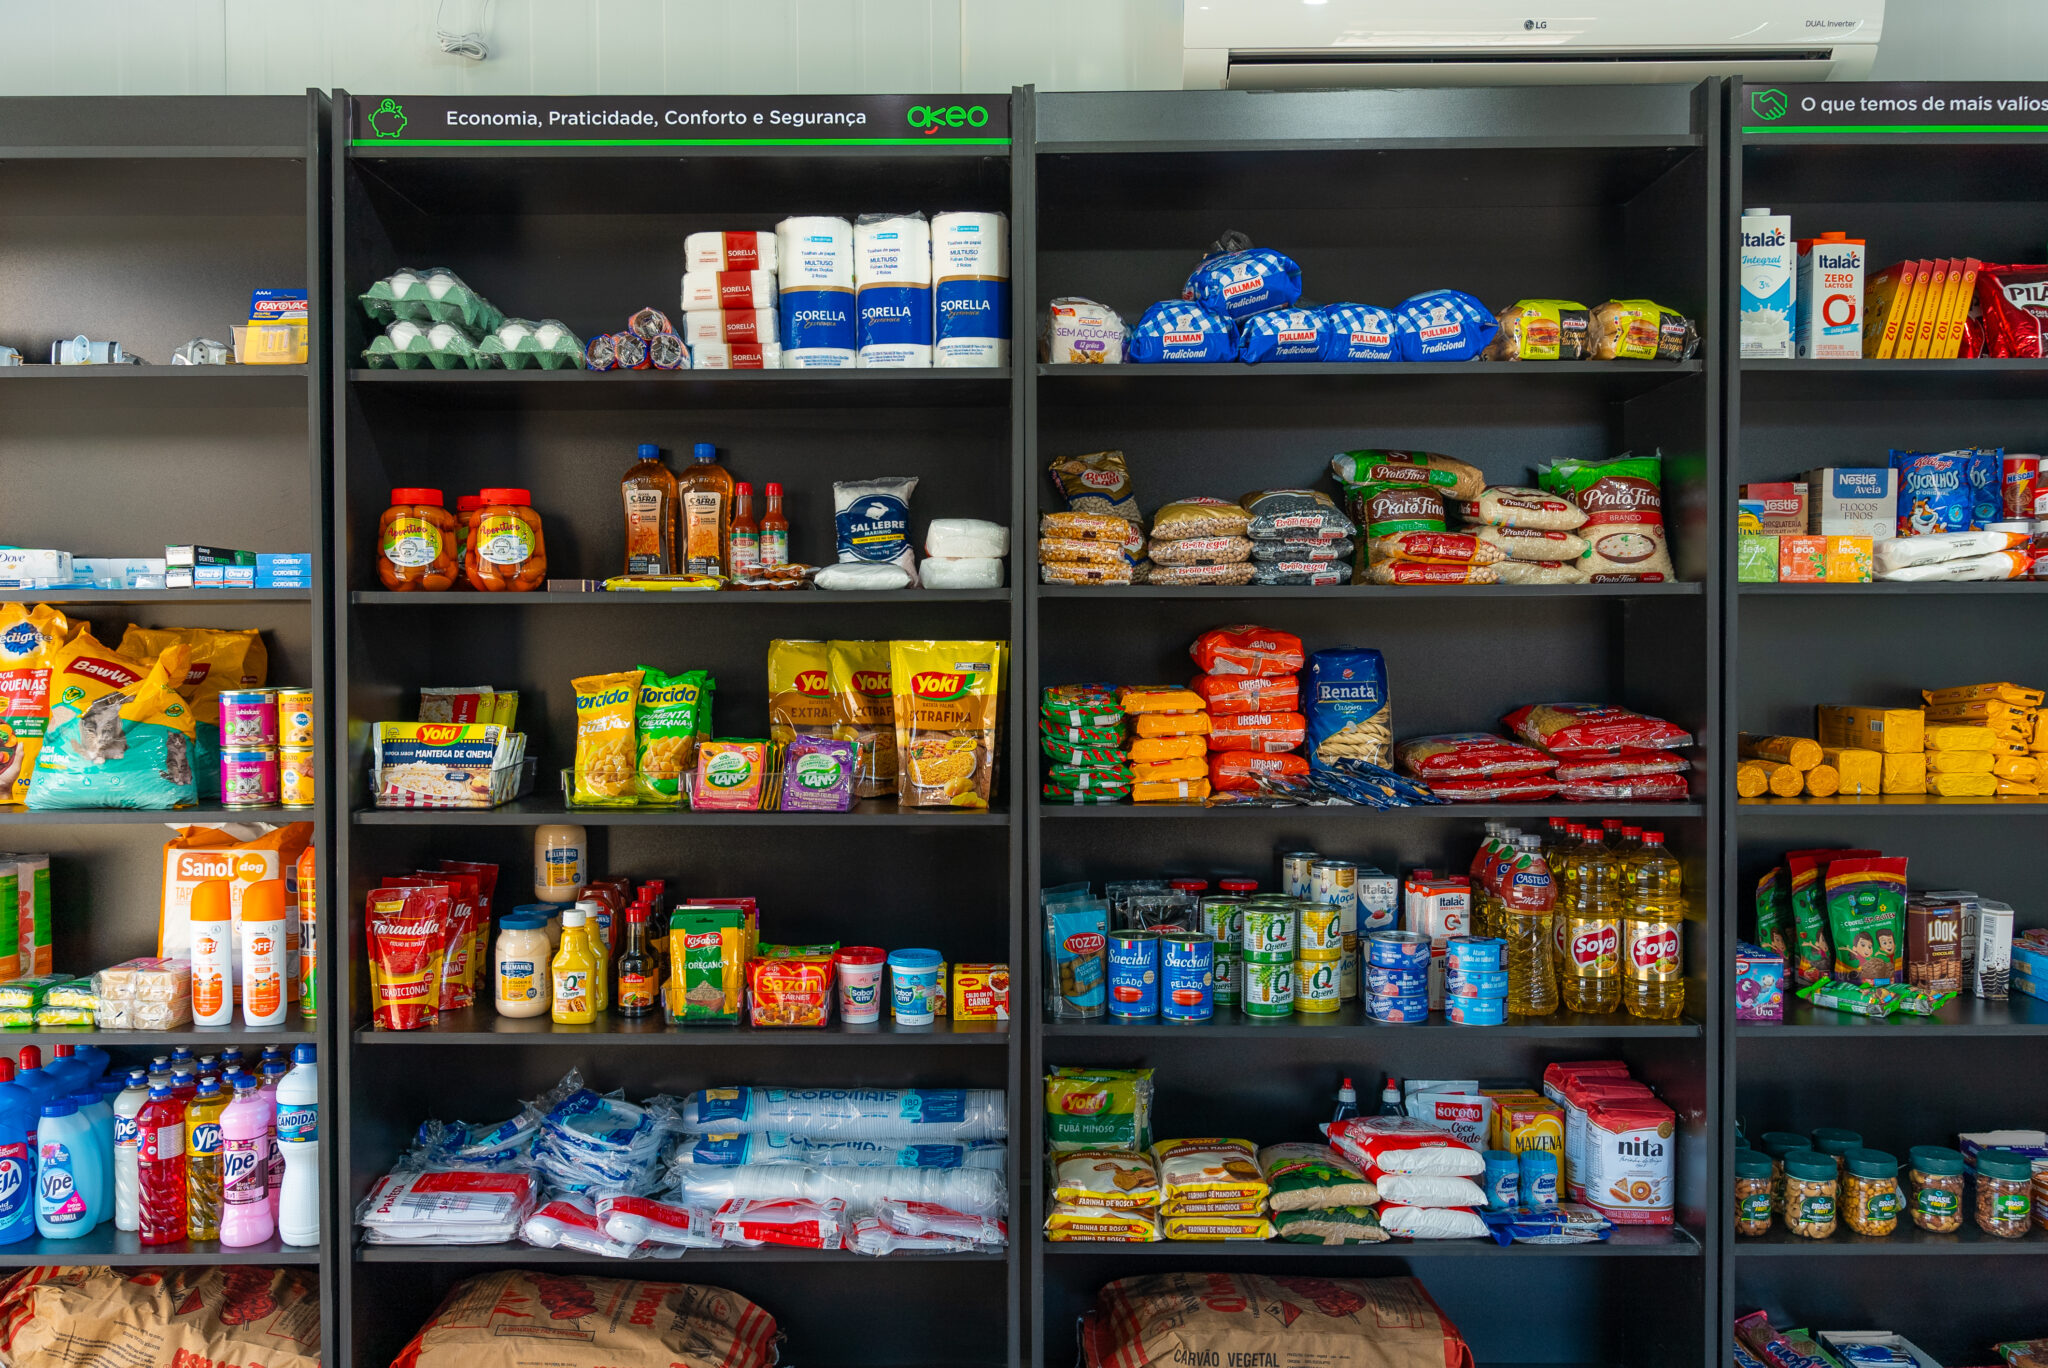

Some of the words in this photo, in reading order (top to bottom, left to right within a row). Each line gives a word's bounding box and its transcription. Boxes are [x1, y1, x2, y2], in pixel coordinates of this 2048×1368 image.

[1535, 21, 1547, 29] LG
[1805, 20, 1826, 28] DUAL
[1827, 20, 1857, 28] Inverter
[1801, 97, 1816, 112] O
[1821, 98, 1855, 114] que
[1860, 97, 1917, 112] temos
[1922, 96, 1945, 112] de
[1950, 96, 1992, 111] mais
[447, 110, 543, 127] Economia,
[550, 110, 659, 127] Praticidade,
[665, 110, 747, 125] Conforto
[752, 112, 764, 125] e
[769, 110, 867, 127] Segurança
[907, 105, 989, 129] akeo
[727, 249, 757, 257] SORELLA
[1818, 255, 1861, 270] Italac
[1824, 273, 1854, 283] ZERO
[721, 285, 751, 294] SORELLA
[1223, 278, 1262, 298] PULLMAN
[258, 301, 308, 311] RAYOVAC
[1224, 291, 1269, 310] Tradicional
[795, 310, 846, 322] SORELLA
[726, 322, 756, 331] SORELLA
[1056, 326, 1077, 337] SEM
[1077, 326, 1122, 341] AÇÚCARES
[1163, 332, 1203, 344] PULLMAN
[1278, 331, 1315, 343] PULLMAN
[732, 353, 762, 361] SORELLA
[1161, 347, 1207, 360] Tradicional
[1275, 346, 1319, 356] Tradicional
[1348, 347, 1392, 360] Tradicional
[1914, 455, 1953, 469] Kellogg's
[1839, 473, 1877, 486] Nestlé
[1907, 470, 1960, 493] SUCRILHOS
[1854, 485, 1882, 495] Aveia
[1372, 497, 1419, 518] Prato
[1418, 496, 1444, 516] Fino
[1501, 498, 1525, 508] Prato
[1763, 499, 1799, 511] Nestlé
[1840, 503, 1879, 512] FLOCOS
[1609, 513, 1642, 522] BRANCO
[1844, 511, 1873, 520] FINOS
[850, 522, 870, 533] SAL
[872, 520, 905, 530] LEBRE
[1763, 520, 1802, 528] HOCOLATERIA
[1792, 545, 1816, 554] leão
[0, 630, 53, 645] edigree
[915, 674, 959, 693] Yoki
[1238, 678, 1272, 690] URBANO
[640, 687, 697, 703] Torcida
[1320, 685, 1376, 699] Renata
[640, 710, 691, 720] PIMENTA
[909, 710, 972, 723] EXTRAFINA
[1237, 714, 1272, 726] URBANO
[641, 719, 687, 727] MEXICANA
[421, 727, 457, 741] Yoki
[415, 749, 453, 758] MANTEIGA
[453, 750, 464, 758] DE
[465, 749, 493, 759] CINEMA
[1250, 757, 1283, 771] URBANO
[711, 769, 747, 785] TANG
[800, 770, 837, 787] TANG
[547, 850, 577, 859] HELLMANN'S
[181, 857, 234, 877] Sanol
[238, 861, 264, 875] dog
[1516, 873, 1550, 885] CASTELO
[1362, 884, 1394, 895] Italac
[1329, 892, 1355, 905] Moça
[1439, 896, 1465, 906] Italac
[372, 919, 440, 936] Tarantella
[1927, 919, 1958, 943] LOOK
[250, 940, 275, 953] OFF!
[1069, 935, 1103, 947] TOZZI
[1264, 941, 1288, 951] Quero
[1575, 934, 1616, 956] Soya
[1635, 936, 1677, 957] Soya
[502, 963, 533, 972] HELLMANN'S
[1111, 976, 1143, 987] PELADO
[1170, 979, 1203, 989] PELADO
[380, 982, 429, 998] TRADICIONAL
[851, 989, 874, 997] Sabor
[780, 993, 810, 1001] CARNES
[1755, 1005, 1774, 1017] Uva
[1437, 1106, 1481, 1120] SOCOCO
[1058, 1123, 1081, 1133] FUBÁ
[1082, 1124, 1115, 1133] MIMOSO
[1451, 1121, 1475, 1133] Coco
[1515, 1135, 1563, 1152] MAIZENA
[1617, 1136, 1664, 1157] nita
[42, 1174, 72, 1198] Ypê
[1187, 1192, 1207, 1200] FARINHA
[1208, 1191, 1215, 1199] DE
[1214, 1190, 1242, 1198] MANDIOCA
[1928, 1193, 1951, 1203] BRASIL
[1079, 1198, 1105, 1207] FARINHA
[1105, 1198, 1113, 1206] DE
[1114, 1199, 1134, 1207] ROSCA
[1186, 1204, 1206, 1212] FARINHA
[1213, 1203, 1241, 1211] MANDIOCA
[1072, 1223, 1098, 1231] FARINHA
[1108, 1224, 1128, 1232] ROSCA
[1188, 1226, 1208, 1234] FARINHA
[1216, 1225, 1242, 1233] MANDIOCA
[1173, 1348, 1220, 1368] CARVÃO
[1228, 1352, 1281, 1368] VEGETAL
